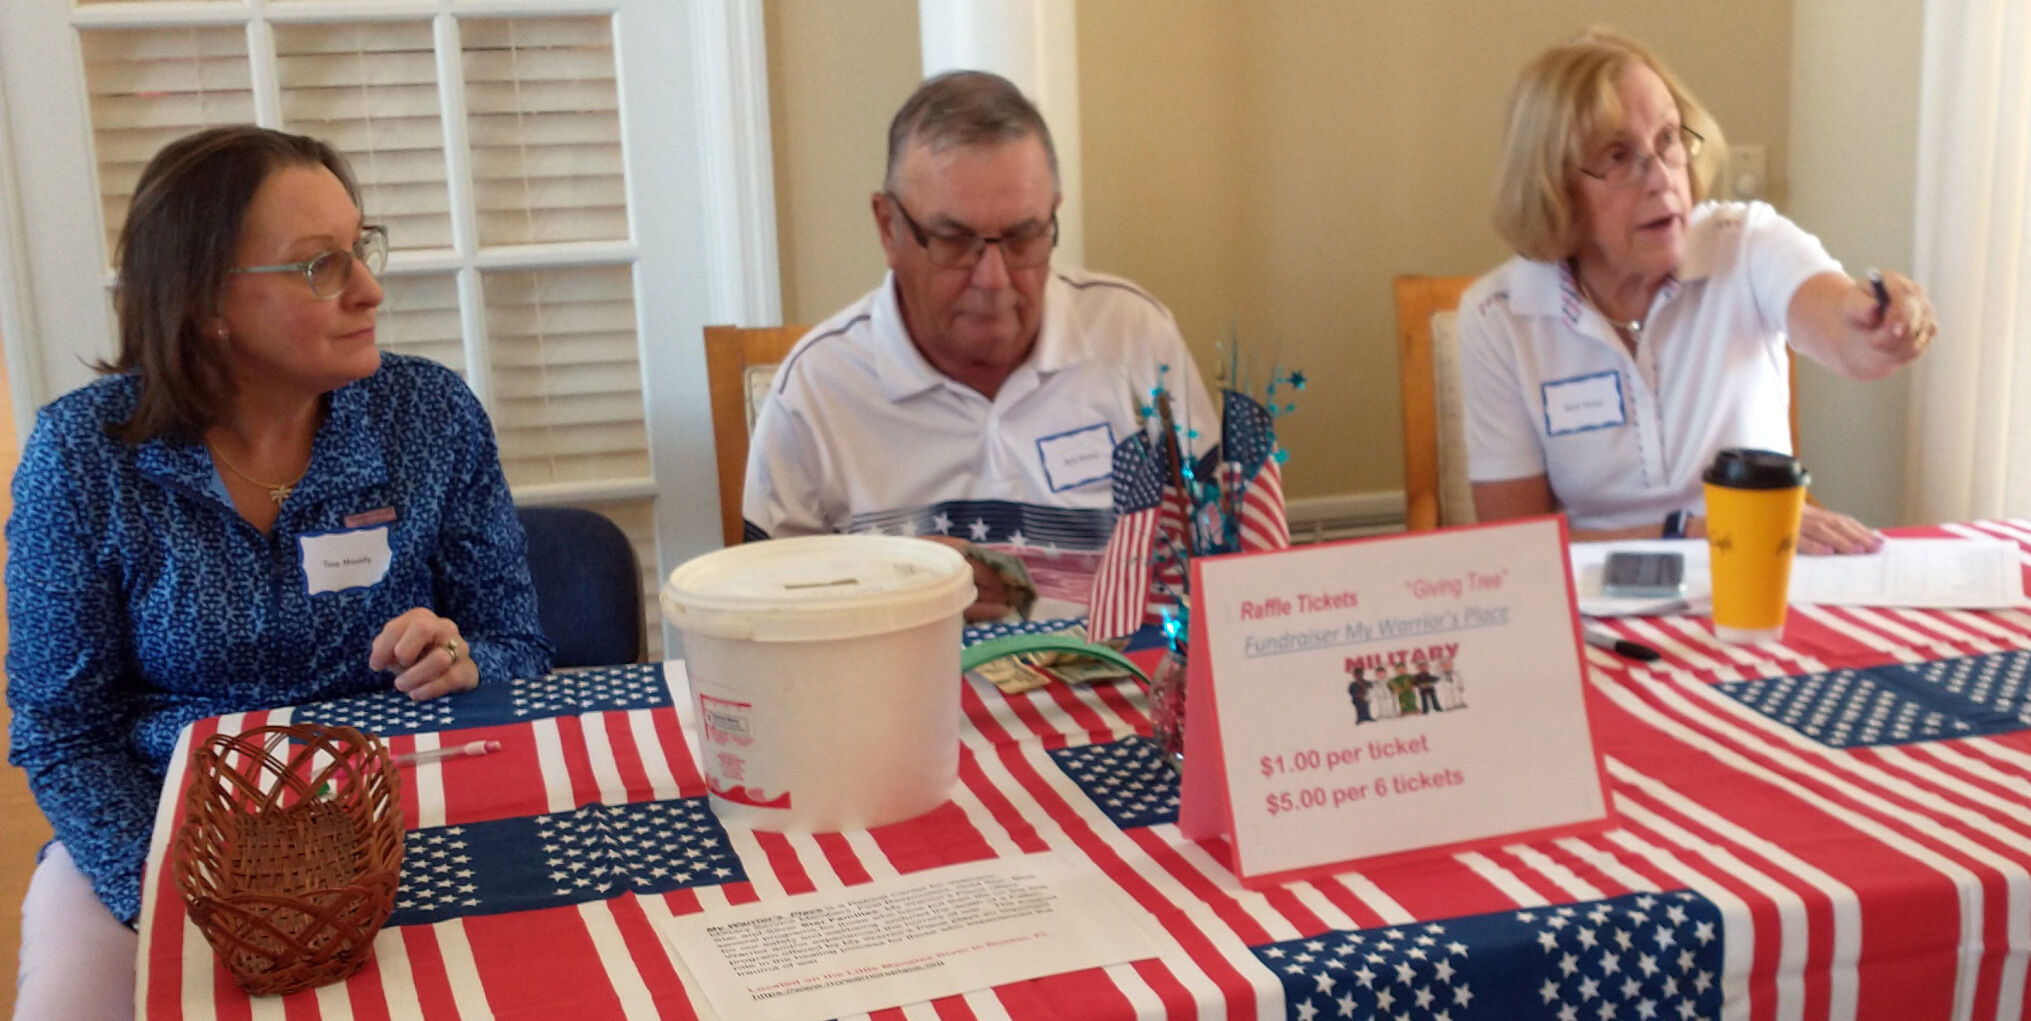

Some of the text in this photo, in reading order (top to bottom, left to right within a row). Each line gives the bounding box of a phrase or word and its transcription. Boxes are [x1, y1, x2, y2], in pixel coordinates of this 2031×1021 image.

[1240, 590, 1358, 621] Raffle Tickets
[1244, 628, 1339, 657] Fundraiser
[1345, 619, 1373, 645] My
[1463, 604, 1510, 628] Place
[1344, 642, 1459, 671] MILITARY
[1260, 734, 1430, 778] $1.00 per ticket
[1266, 768, 1465, 817] $5.00 per 6 tickets
